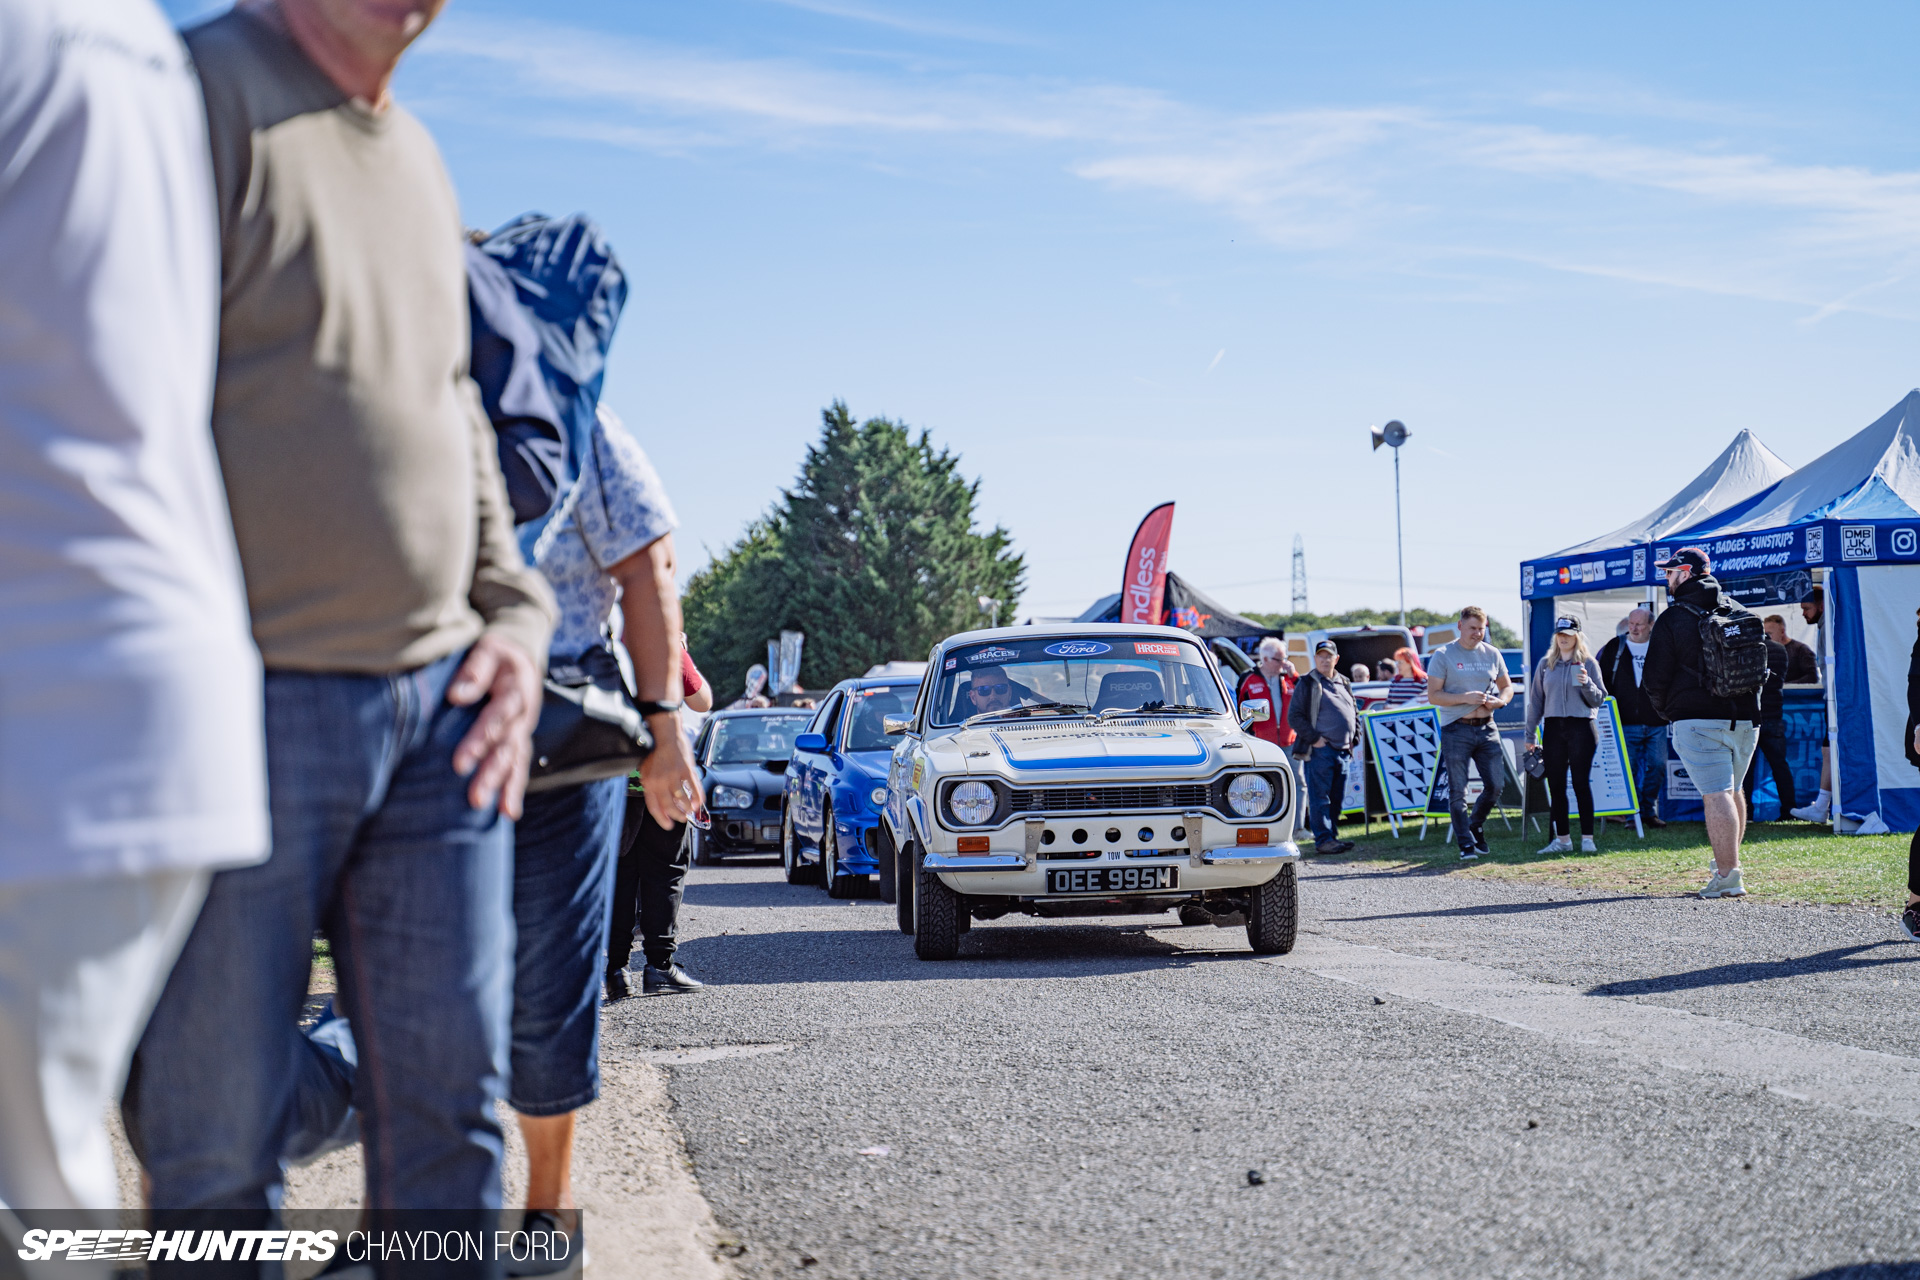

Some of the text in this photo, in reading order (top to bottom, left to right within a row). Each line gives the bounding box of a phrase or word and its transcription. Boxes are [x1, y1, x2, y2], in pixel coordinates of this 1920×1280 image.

[1845, 529, 1871, 539] DMB
[1715, 538, 1746, 555] BADGES
[1750, 531, 1794, 550] SUNSTRIPS
[1845, 548, 1872, 557] COM
[1721, 555, 1769, 572] WORKSHOP
[1766, 552, 1791, 566] MATS
[1130, 547, 1156, 624] ndless
[1058, 642, 1097, 654] Ford
[1137, 644, 1164, 654] HRCR
[1110, 681, 1153, 692] RECARO
[1108, 851, 1121, 860] TOW
[1055, 867, 1171, 891] OEE 995M
